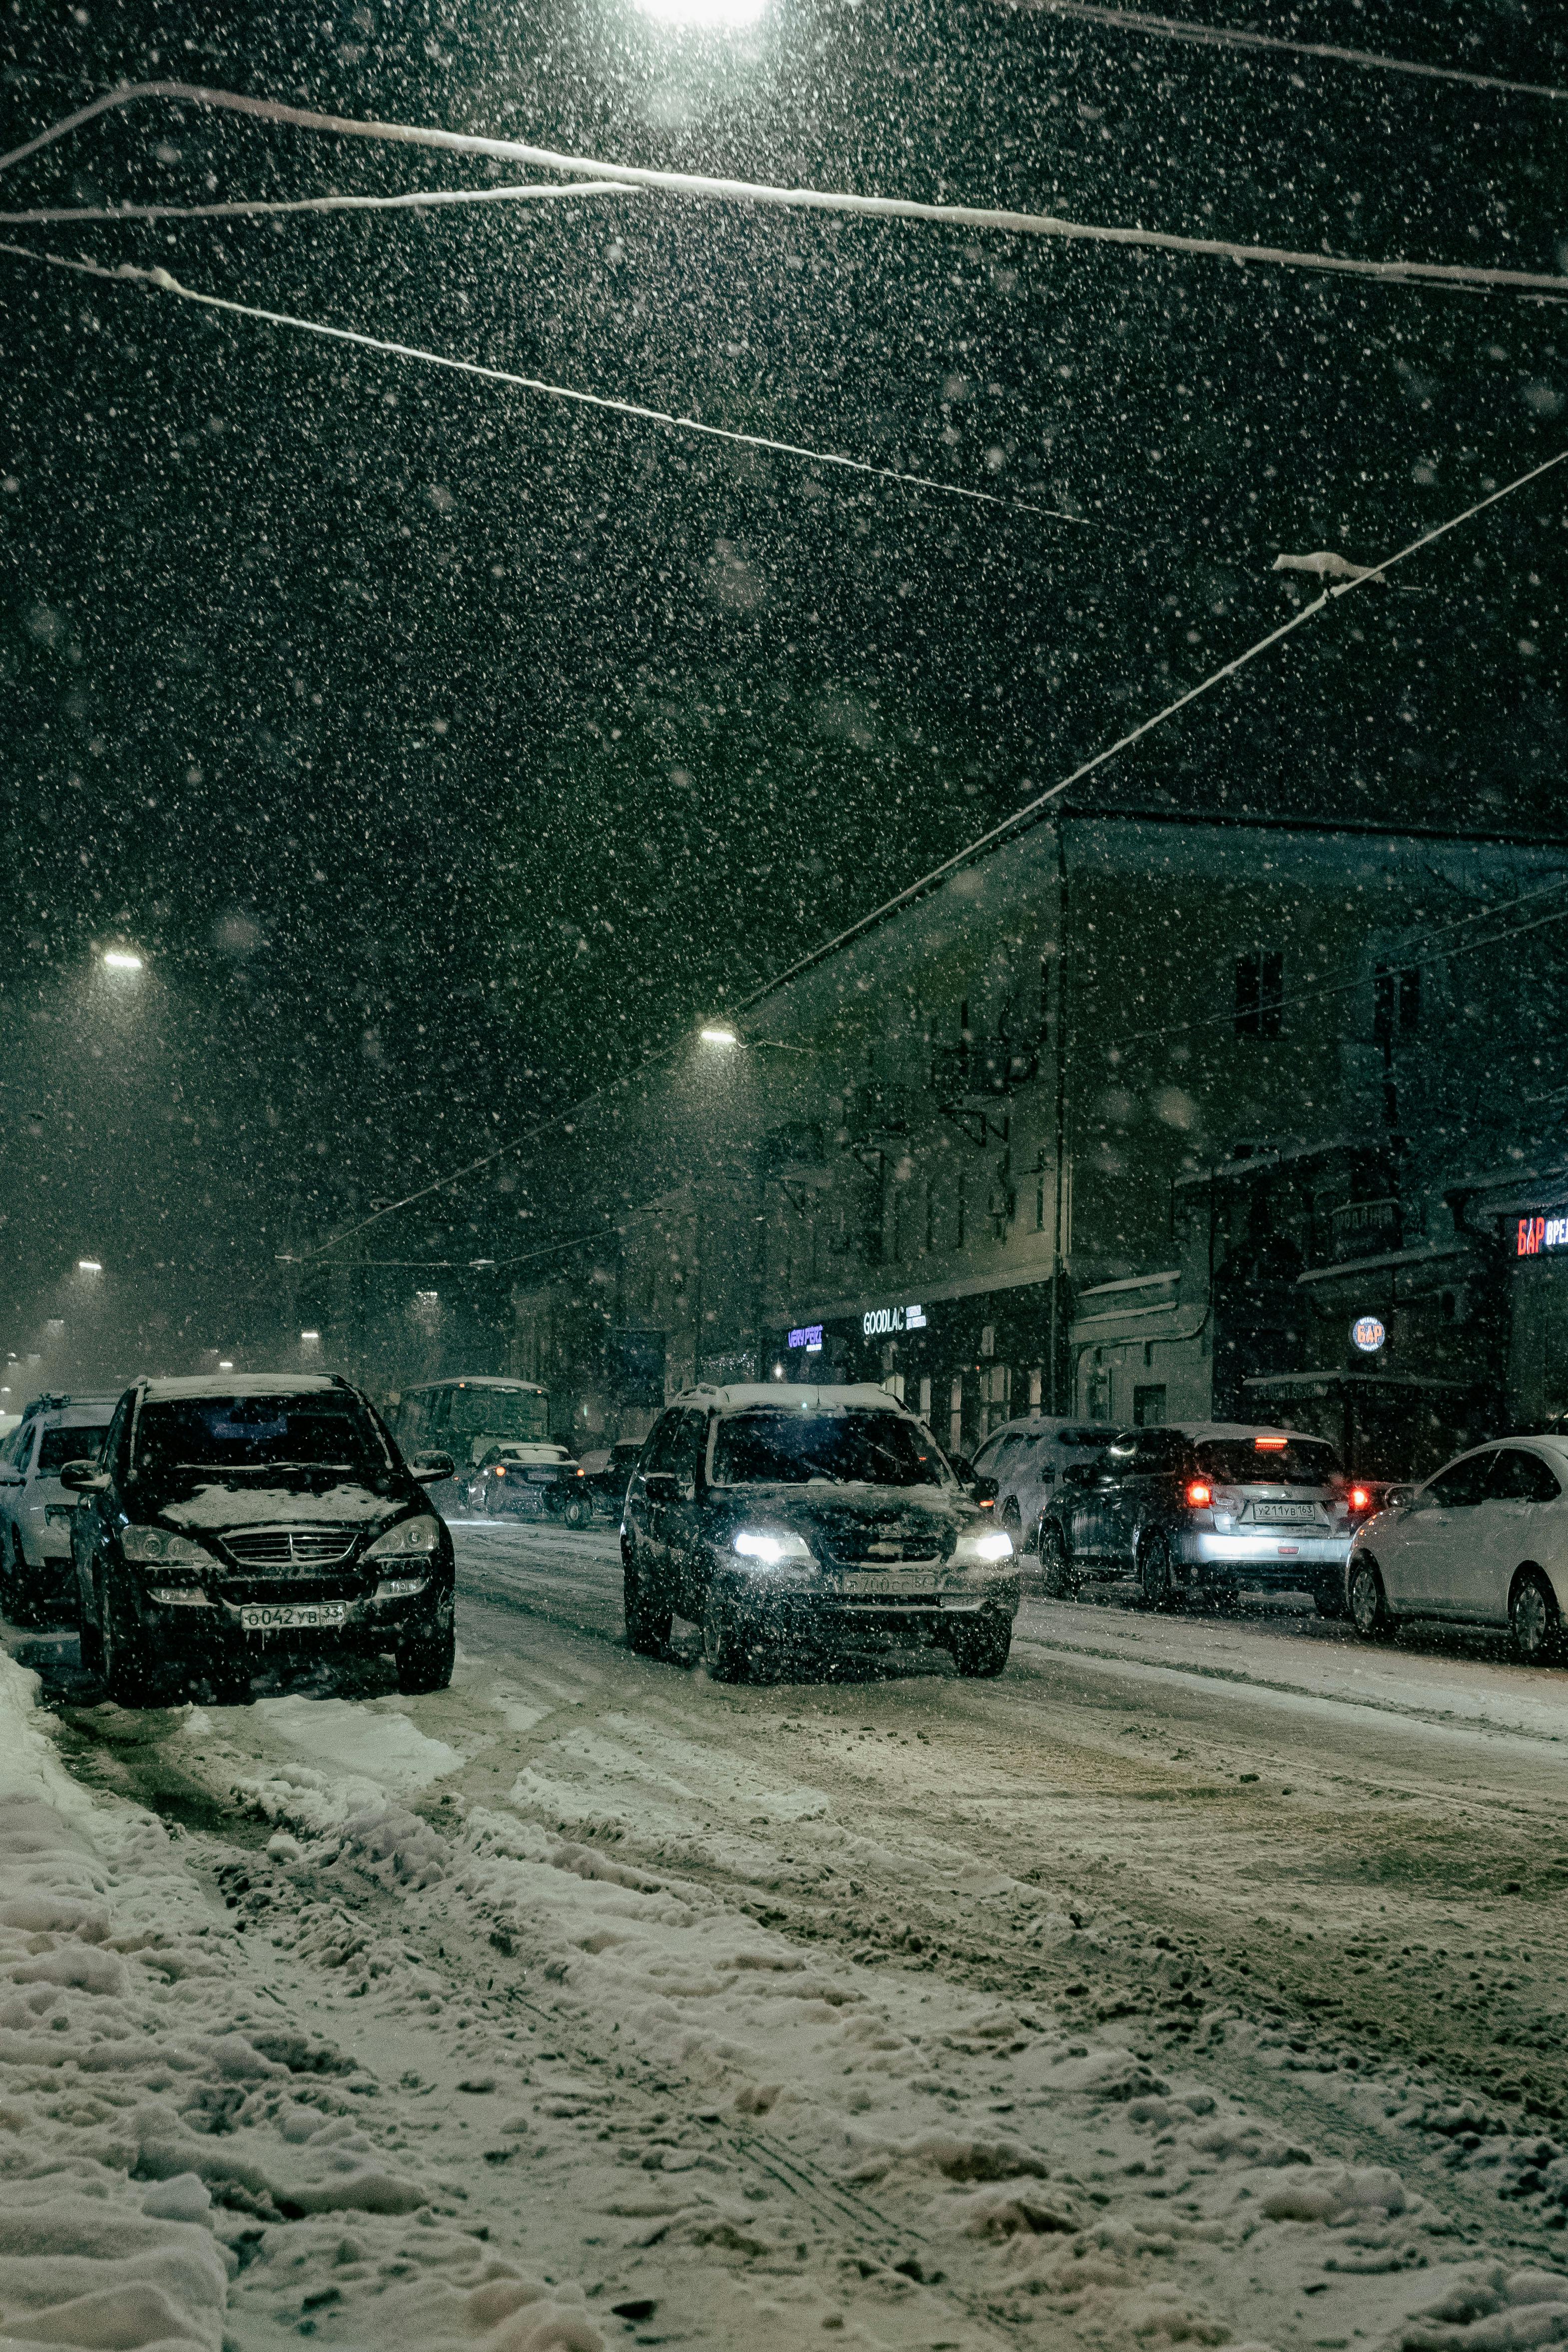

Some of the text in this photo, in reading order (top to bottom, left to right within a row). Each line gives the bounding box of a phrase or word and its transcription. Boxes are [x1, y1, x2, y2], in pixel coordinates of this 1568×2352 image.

[1518, 1216, 1568, 1255] БАР ВРЕ
[863, 1306, 904, 1334] GOODLAC
[1357, 1325, 1382, 1343] БАР
[1297, 1505, 1312, 1514] 163
